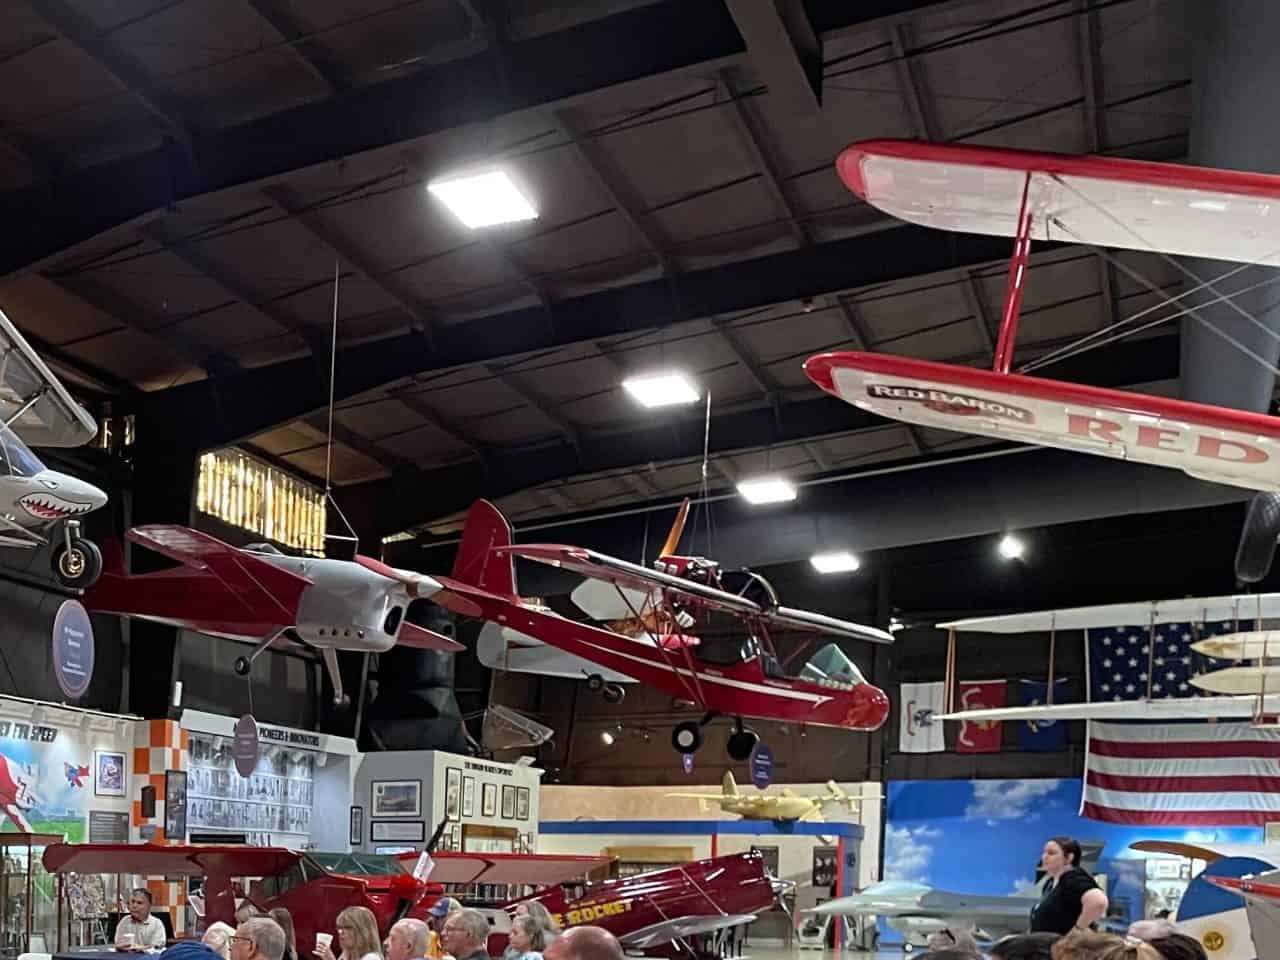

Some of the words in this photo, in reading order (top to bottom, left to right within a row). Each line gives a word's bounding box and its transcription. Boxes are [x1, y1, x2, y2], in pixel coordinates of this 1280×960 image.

[874, 386, 925, 400] RED
[929, 391, 1026, 420] BARON
[1068, 414, 1269, 464] RED
[31, 725, 58, 743] SPEED
[567, 898, 634, 925] ROCKET
